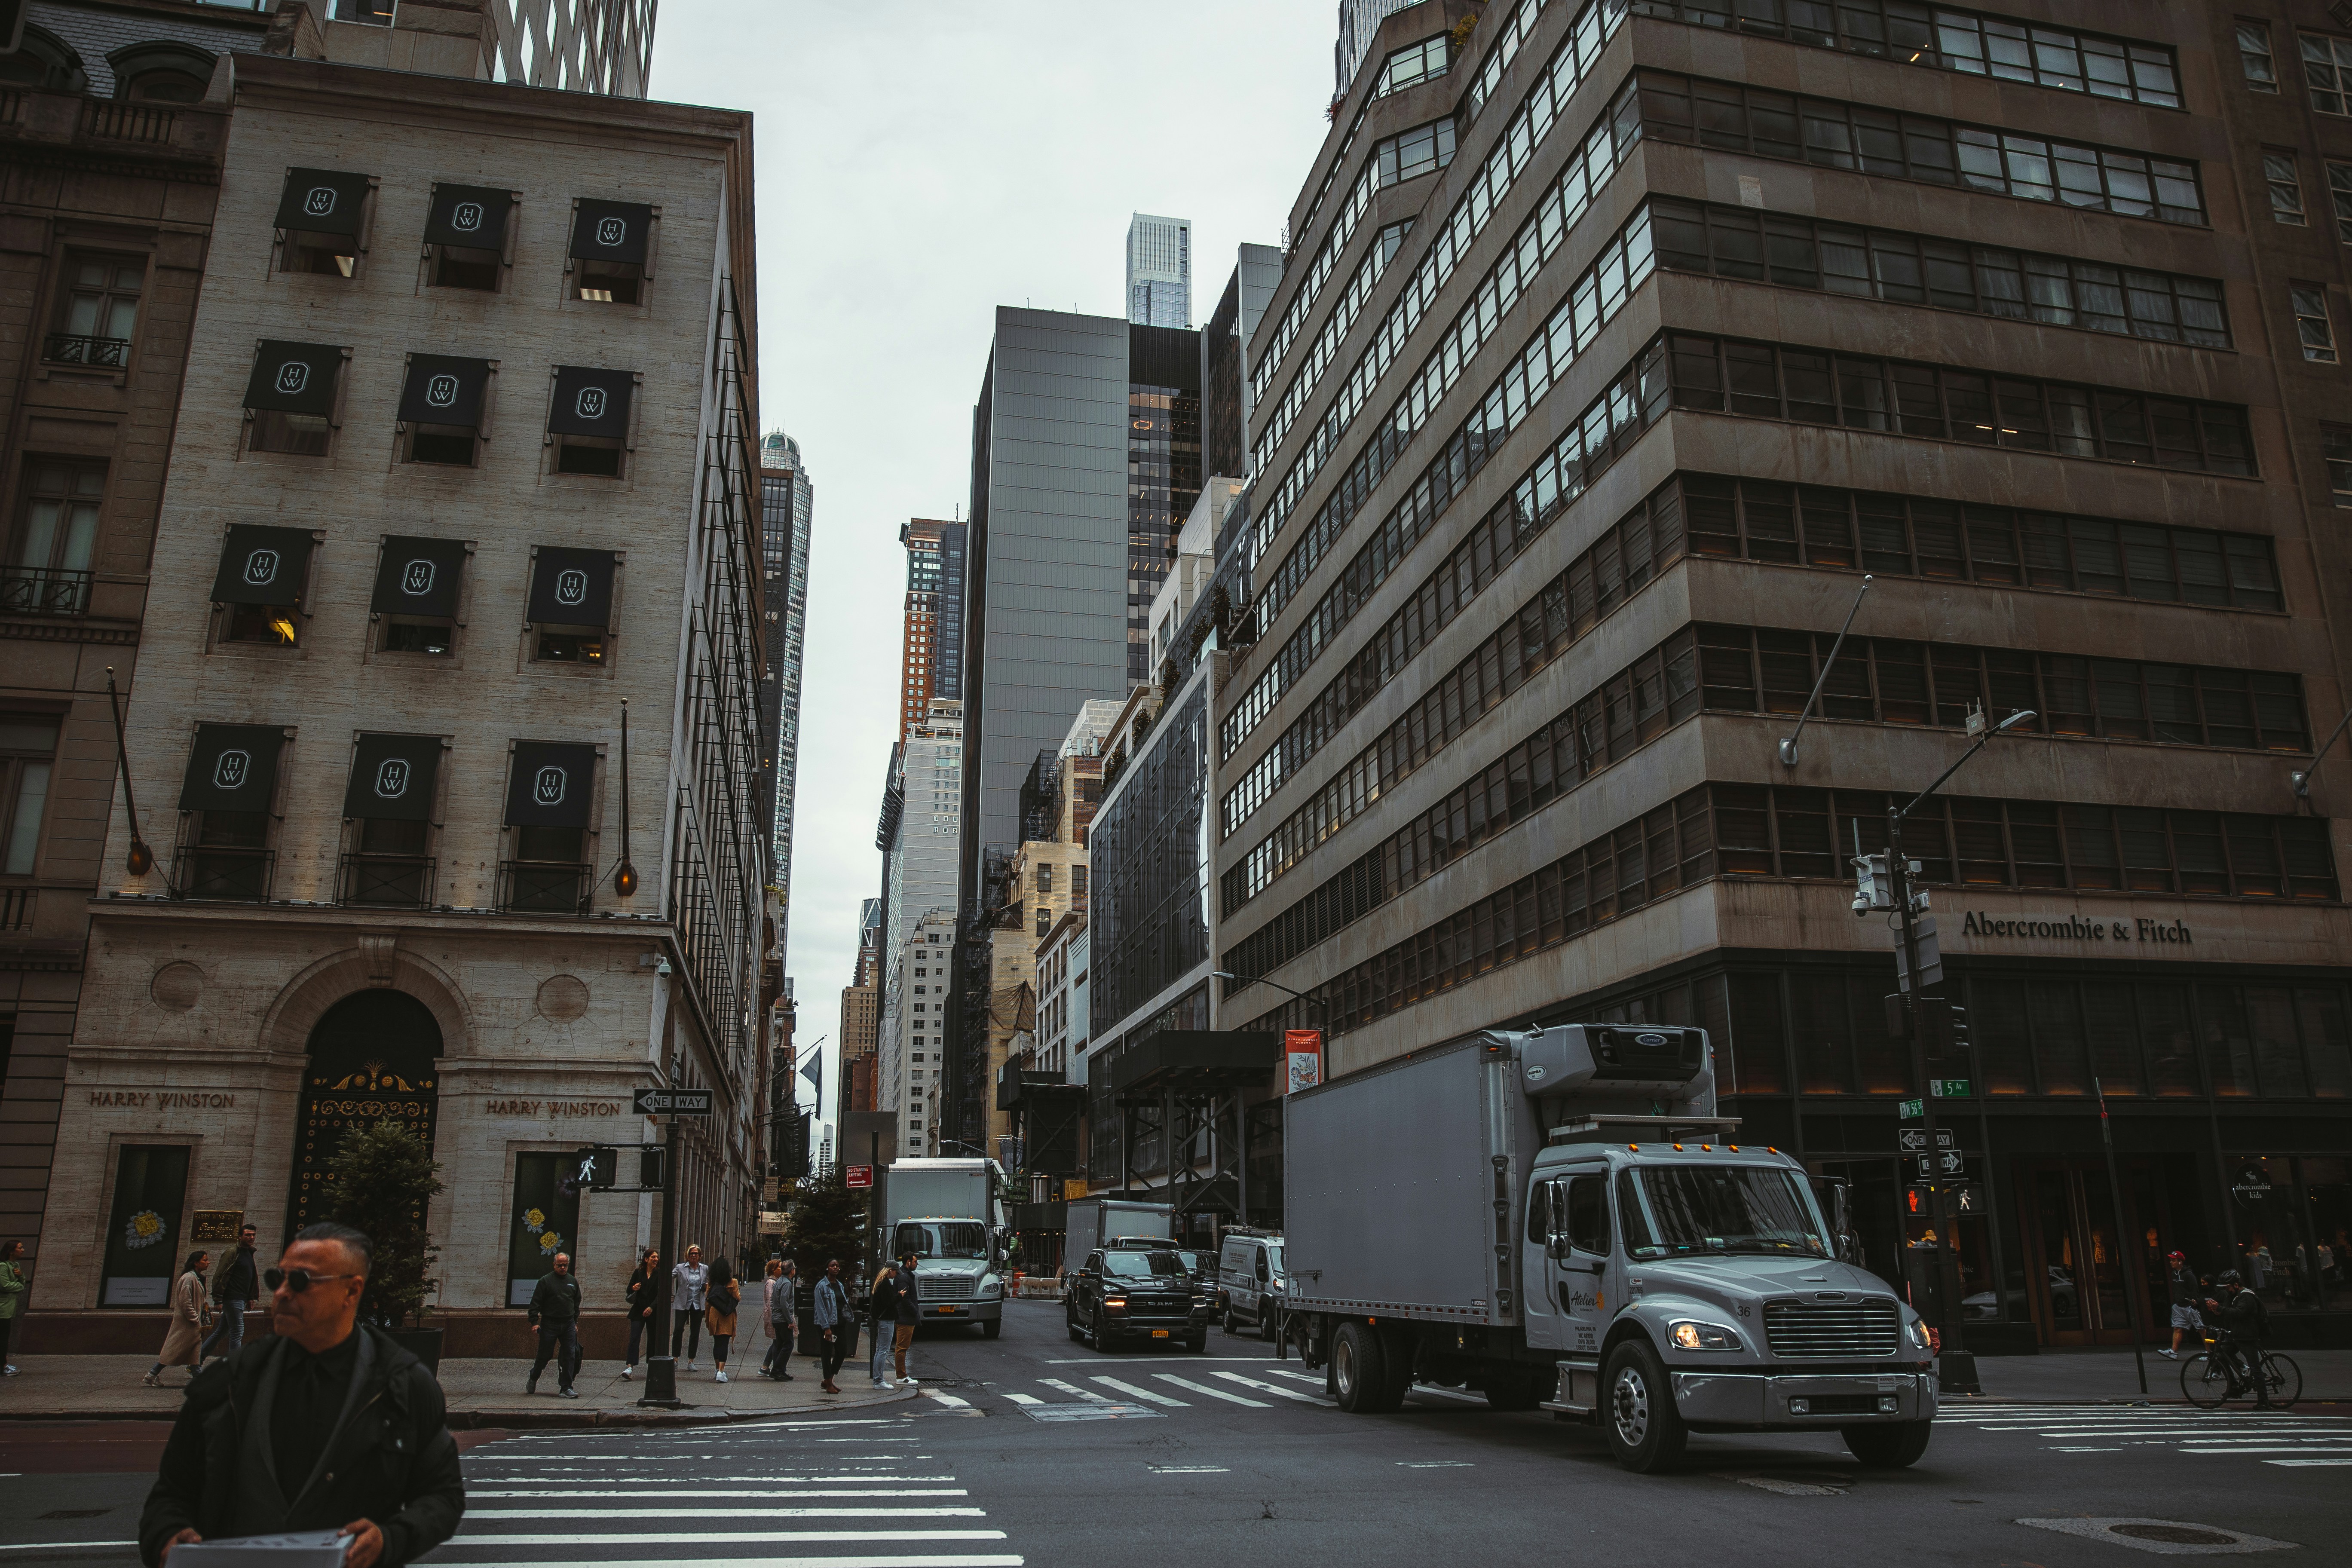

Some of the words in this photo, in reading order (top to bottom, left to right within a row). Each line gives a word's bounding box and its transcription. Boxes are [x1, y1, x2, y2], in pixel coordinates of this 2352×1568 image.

[1963, 910, 2104, 939] Abercrombie
[2113, 922, 2130, 940] &
[2135, 918, 2192, 943] Fitch
[1948, 1082, 1953, 1094] 5
[90, 1092, 150, 1106] HARRY
[156, 1093, 235, 1108] WINSTON
[646, 1097, 668, 1107] ONE
[679, 1097, 702, 1107] WAY
[487, 1100, 541, 1114] HARRY
[547, 1101, 620, 1115] WINSTON
[1905, 1104, 1910, 1115] W
[1911, 1103, 1917, 1115] 56
[1908, 1136, 1924, 1144] ONE
[1938, 1136, 1948, 1144] AY
[1942, 1158, 1955, 1167] WAY
[2272, 1267, 2290, 1275] Fitch
[1571, 1290, 1599, 1306] Atelier
[1737, 1306, 1751, 1317] 36
